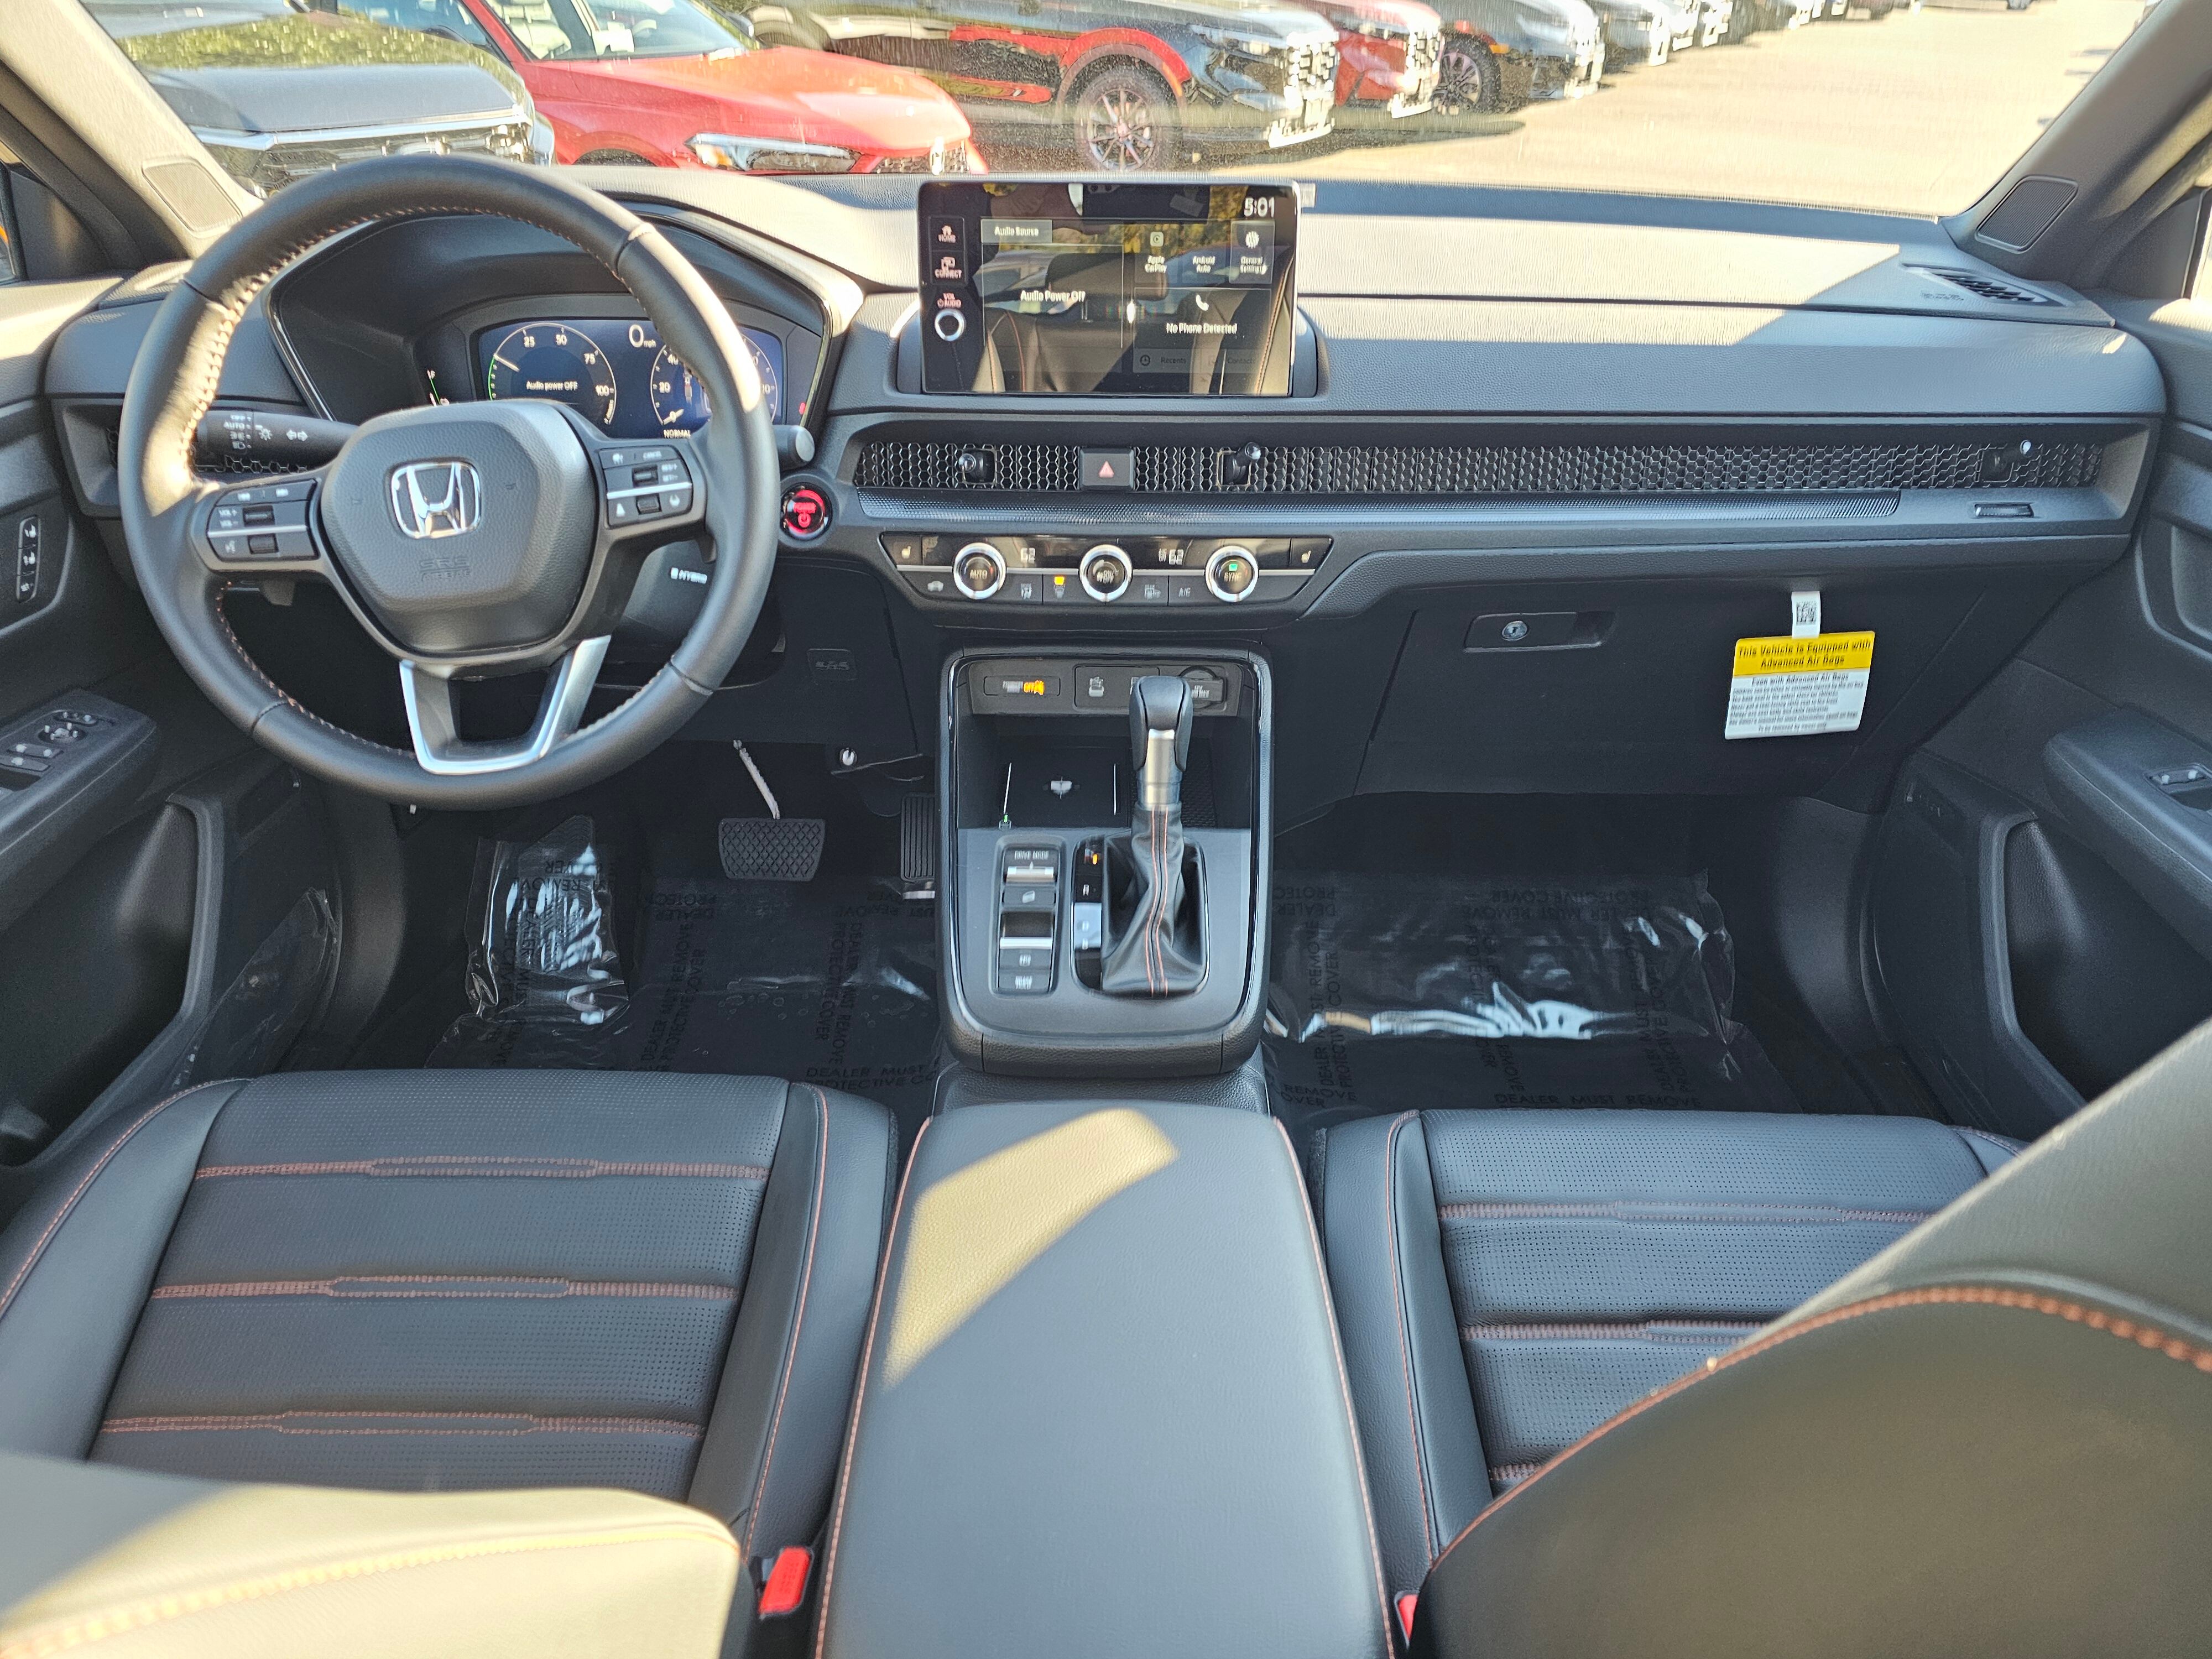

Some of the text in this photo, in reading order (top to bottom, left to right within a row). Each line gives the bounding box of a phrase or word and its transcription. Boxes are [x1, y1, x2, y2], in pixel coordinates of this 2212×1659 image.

[1245, 197, 1275, 217] 5:01
[995, 226, 1039, 236] Audio Source
[938, 234, 956, 243] HOME
[1240, 256, 1263, 265] General
[935, 269, 962, 279] CONNECT
[1196, 264, 1211, 273] Auto
[1020, 290, 1043, 302] Audio
[1045, 290, 1070, 302] Power
[944, 299, 961, 308] AUDIO
[1166, 323, 1238, 334] No Phone Detected
[524, 336, 535, 348] 25
[556, 335, 567, 346] 50
[629, 324, 656, 348] 0 mph
[583, 353, 596, 365] 75
[526, 380, 578, 392] Audio power OFF
[596, 385, 609, 397] 100
[223, 422, 245, 430] AUTO
[970, 570, 987, 580] AUTO
[1224, 572, 1242, 582] SYNC
[1178, 587, 1191, 597] A/C
[1738, 645, 1757, 656] This
[1760, 644, 1793, 655] Vehicle
[1807, 641, 1849, 654] Equipped
[1852, 639, 1871, 650] with
[1760, 653, 1845, 667] Advanced Air Bags
[1751, 671, 1849, 686] Even with Advanced Air Bags
[1015, 851, 1049, 860] DRIVE MODE
[671, 922, 693, 982] REMOVE
[1305, 920, 1325, 989] REMOVE
[685, 948, 706, 994] COVER
[1325, 951, 1343, 1007] COVER
[815, 1000, 836, 1040] COVER
[806, 1065, 926, 1078] DEALER MUST
[1314, 1045, 1335, 1087] DEALER
[1280, 1091, 1327, 1107] OVER
[1494, 1093, 1561, 1105] DEALER
[1626, 1093, 1702, 1105] REMOVE
